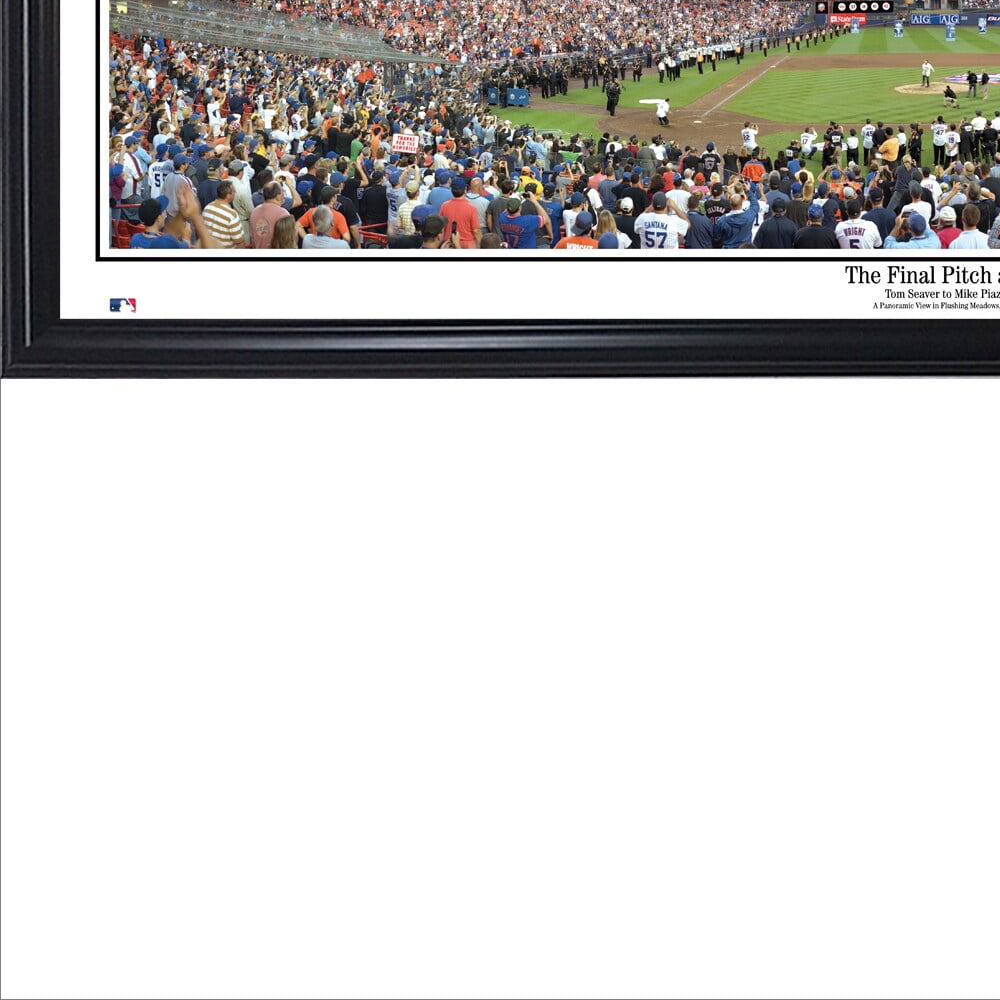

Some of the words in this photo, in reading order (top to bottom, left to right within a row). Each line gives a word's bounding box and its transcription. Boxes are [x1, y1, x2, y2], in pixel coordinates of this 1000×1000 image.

[912, 15, 930, 24] AIG
[940, 15, 958, 24] AIG
[644, 220, 668, 231] SANTANA
[843, 226, 866, 236] WRIGHT
[645, 231, 668, 249] 57
